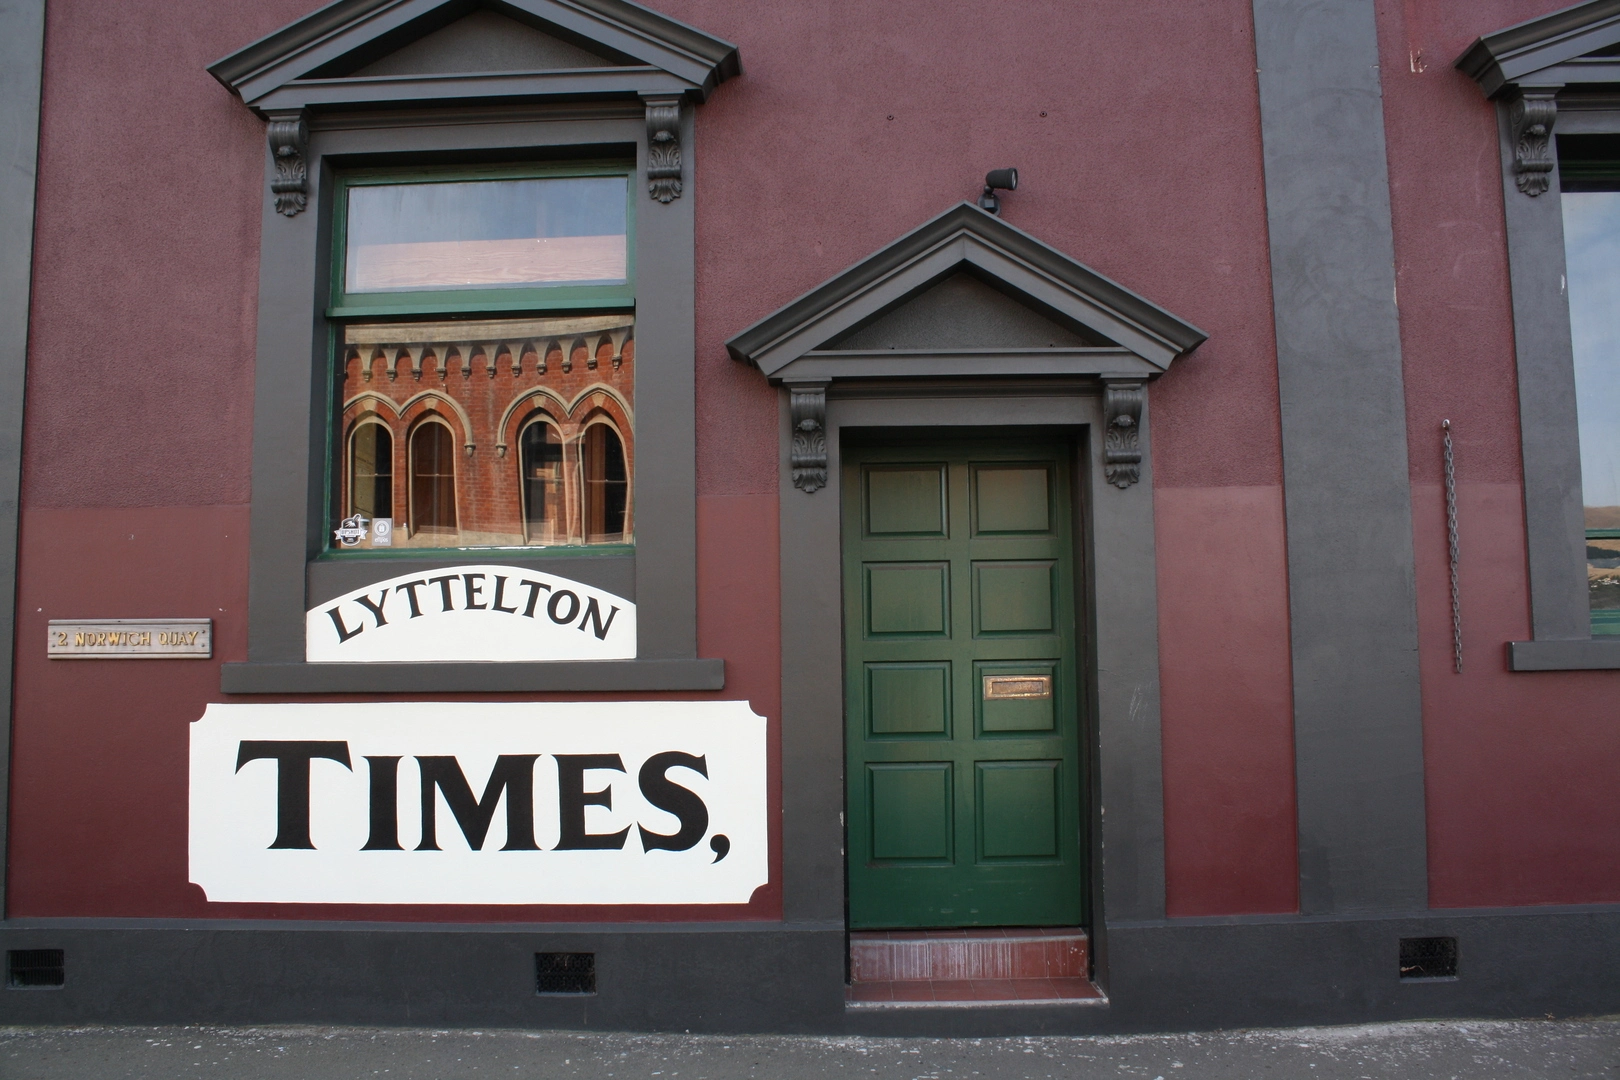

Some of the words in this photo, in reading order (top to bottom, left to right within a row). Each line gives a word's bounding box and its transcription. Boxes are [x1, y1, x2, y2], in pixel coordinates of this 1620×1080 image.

[57, 631, 69, 647] 2
[74, 631, 152, 647] NORWICH
[157, 631, 199, 646] QUAY
[325, 573, 621, 644] LYTTELTON
[234, 739, 731, 865] TIMES,
